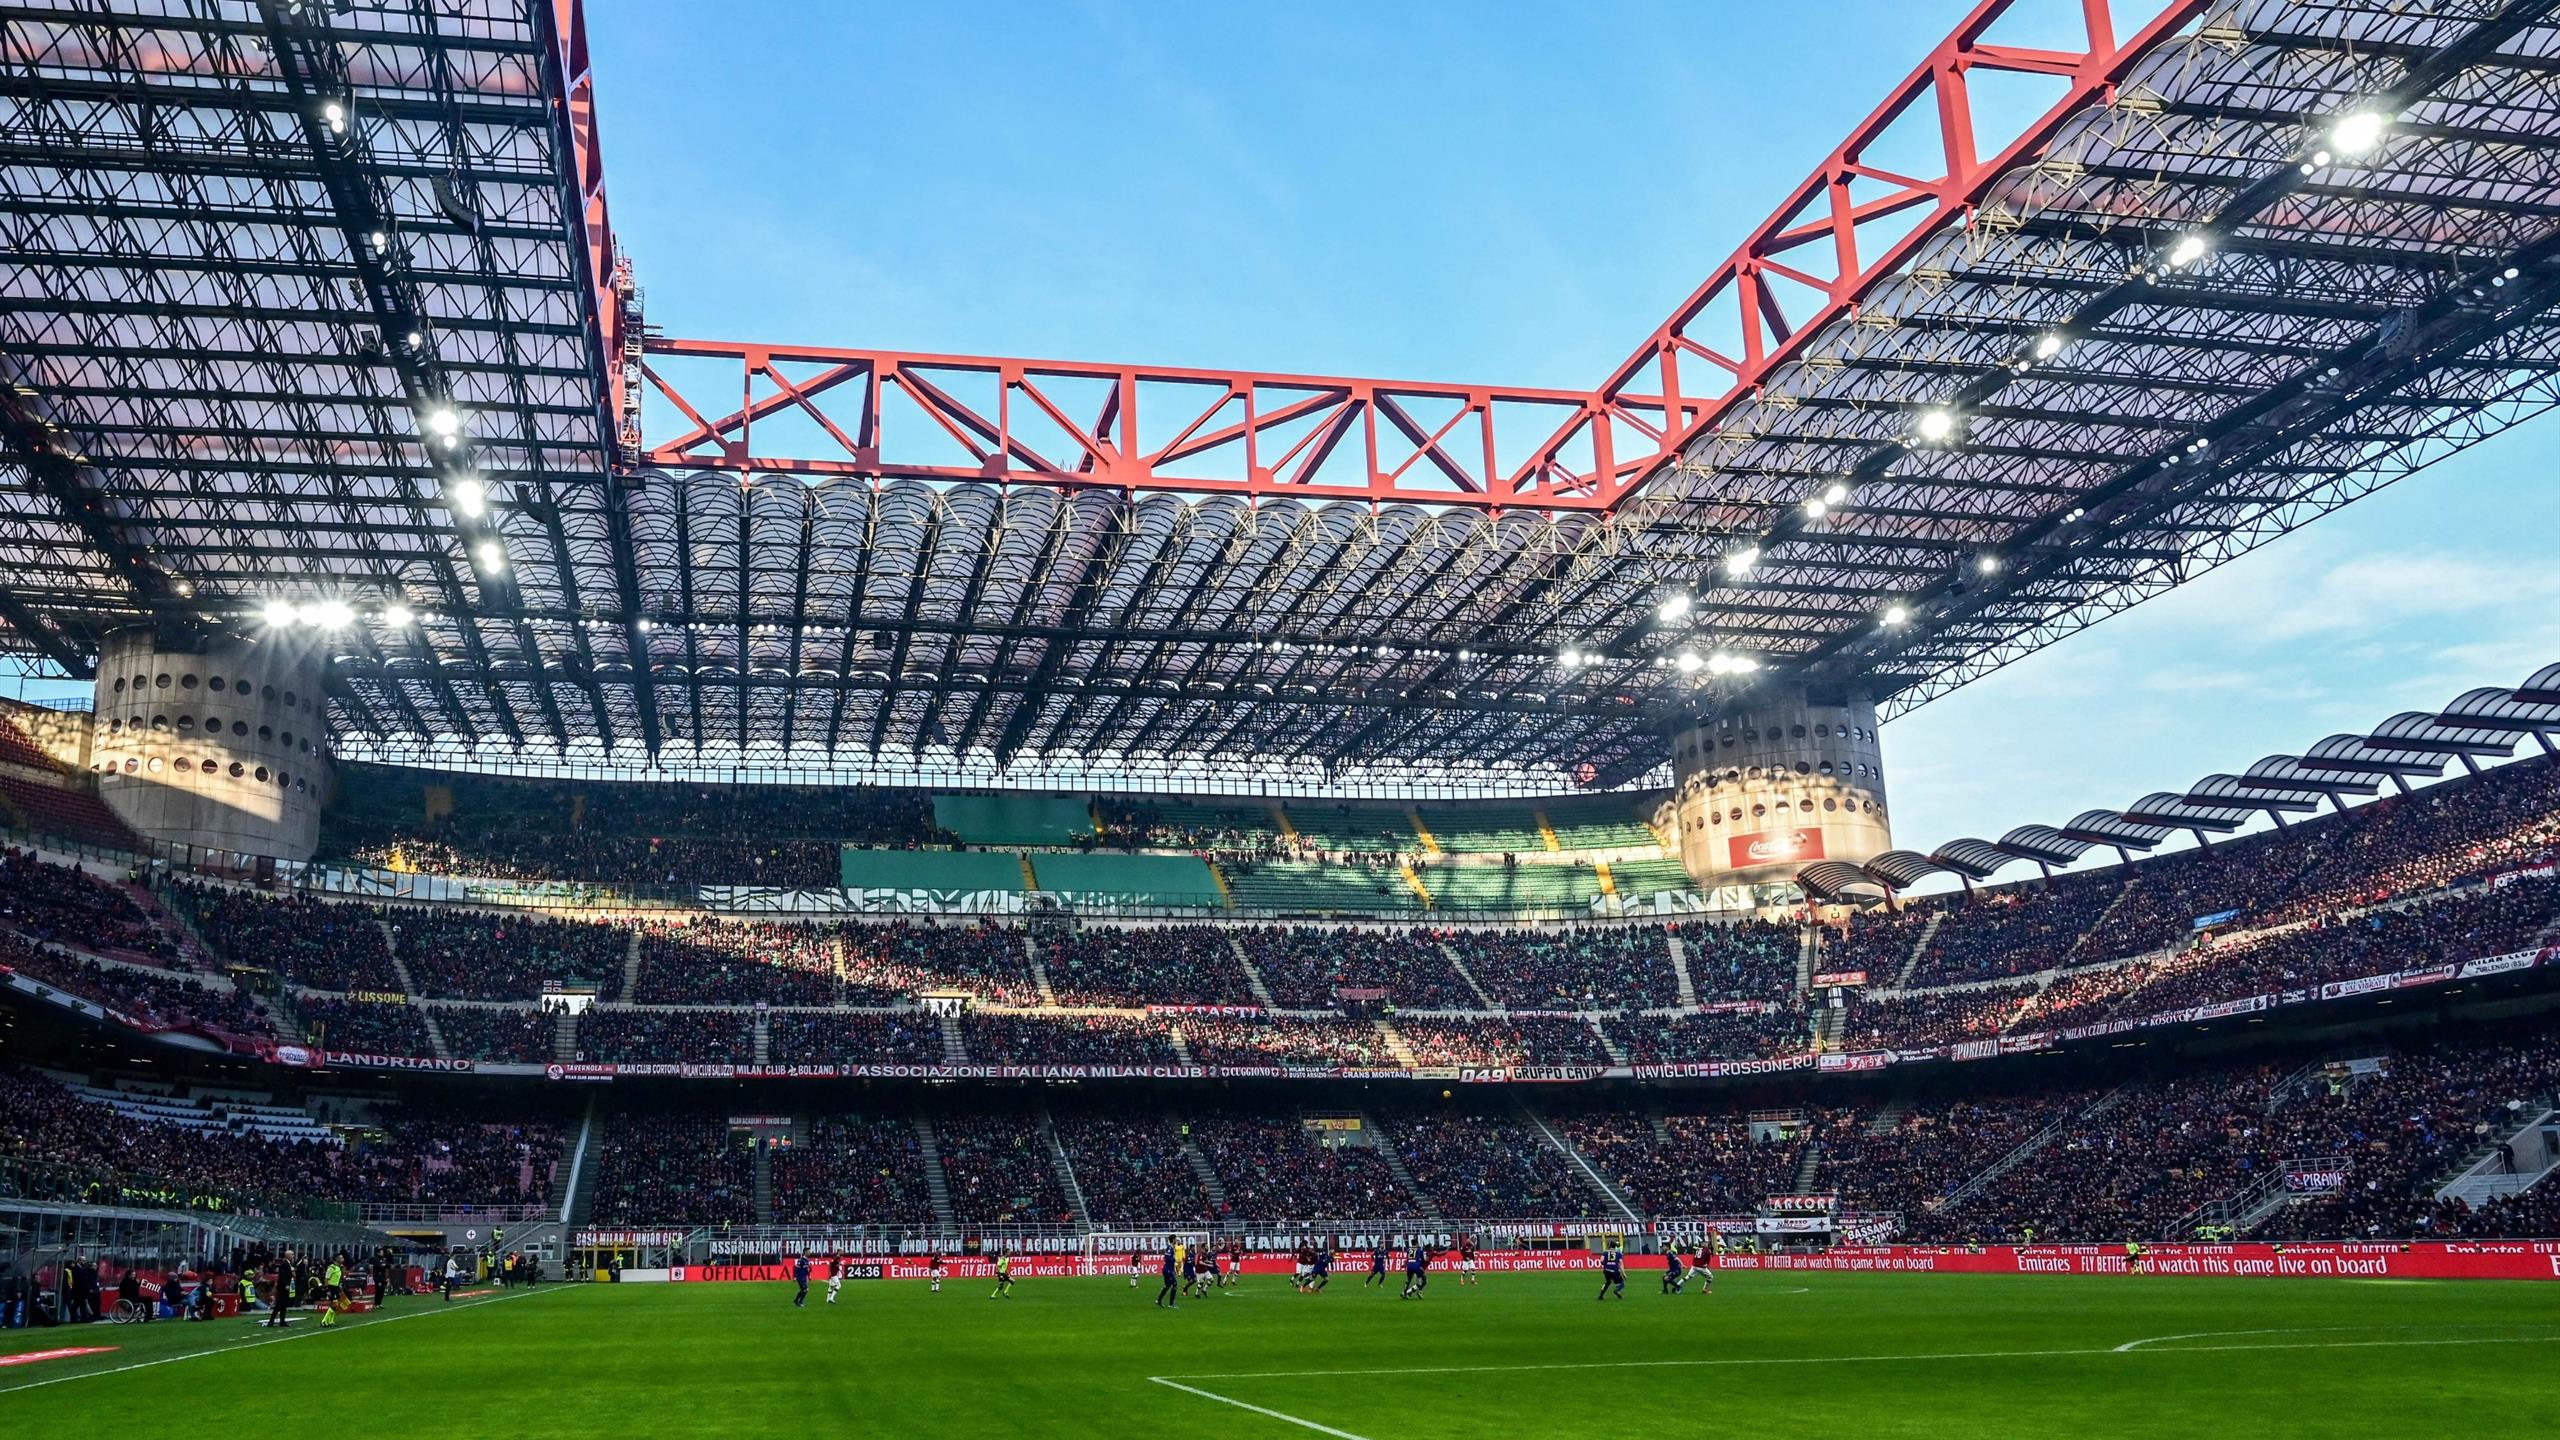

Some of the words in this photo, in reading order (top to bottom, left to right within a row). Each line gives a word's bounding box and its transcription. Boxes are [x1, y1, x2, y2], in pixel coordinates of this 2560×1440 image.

[358, 991, 406, 1005] LISSONE
[2065, 1024, 2087, 1040] MILAN
[2088, 1021, 2108, 1037] CLUB
[2108, 1018, 2134, 1034] LATINA
[1922, 1046, 1938, 1054] Club
[325, 1052, 470, 1072] LANDRIANO
[1902, 1053, 1934, 1062] Albania
[566, 1064, 603, 1072] TAVERNOLA
[617, 1064, 636, 1074] MILAN
[636, 1064, 652, 1074] CLUB
[652, 1064, 681, 1074] CORTONA
[699, 1064, 711, 1077] CLUB
[736, 1064, 762, 1076] MILAN
[765, 1064, 786, 1076] CLUB
[798, 1064, 834, 1076] BOLZANO
[856, 1066, 997, 1077] ASSOCIAZIONE
[1003, 1066, 1086, 1077] ITALIANA
[1091, 1066, 1148, 1078] MILAN
[1153, 1066, 1204, 1078] CLUB
[1230, 1067, 1271, 1076] CUGGIONO
[1636, 1064, 1698, 1080] NAVIGLIO
[1719, 1054, 1813, 1077] ROSSONERO
[1342, 1071, 1370, 1079] CRANS
[1371, 1071, 1412, 1079] MONTANA
[1462, 1069, 1506, 1082] 049
[1513, 1068, 1562, 1080] GRUPPO
[1774, 1197, 1836, 1210] ARCORE
[1655, 1221, 1706, 1232] DESIO
[1716, 1221, 1754, 1233] SEREGNO
[1847, 1219, 1893, 1240] BASSANO
[576, 1232, 597, 1246] CASA
[599, 1232, 624, 1245] MILAN
[1025, 1238, 1086, 1252] ACADEMY
[1098, 1237, 1148, 1251] SCUOLA
[1151, 1237, 1196, 1251] CAIO
[1338, 1235, 1381, 1249] DAY
[865, 1239, 890, 1253] CLUB
[891, 1265, 949, 1278] Emiras
[960, 1264, 976, 1277] FLY
[976, 1264, 997, 1277] BETT
[1010, 1262, 1033, 1276] and
[1036, 1262, 1072, 1276] watch
[1325, 1259, 1370, 1272] irates
[1428, 1258, 1449, 1271] and
[1452, 1258, 1486, 1271] wch
[1488, 1257, 1510, 1270] this
[1513, 1258, 1543, 1272] game
[1546, 1257, 1566, 1269] live
[1569, 1259, 1584, 1269] on
[1719, 1255, 1759, 1269] Emirates
[1764, 1255, 1774, 1269] FLY
[1774, 1255, 1792, 1269] BETTER
[1793, 1256, 1808, 1269] and
[1808, 1256, 1832, 1269] watch
[1834, 1256, 1849, 1269] this
[1851, 1257, 1873, 1272] game
[1875, 1256, 1894, 1270] live
[1894, 1258, 1905, 1270] on
[1906, 1256, 1934, 1270] board
[2017, 1255, 2071, 1271] Emirates
[2081, 1256, 2095, 1272] FLY
[2096, 1256, 2128, 1272] BETTER
[2157, 1256, 2200, 1273] watch
[2202, 1256, 2230, 1273] this
[2233, 1258, 2275, 1276] game
[2277, 1255, 2307, 1273] live
[2310, 1258, 2333, 1274] on
[2335, 1255, 2388, 1274] board
[703, 1266, 774, 1281] OFFICIAL
[846, 1265, 881, 1278] 24:36
